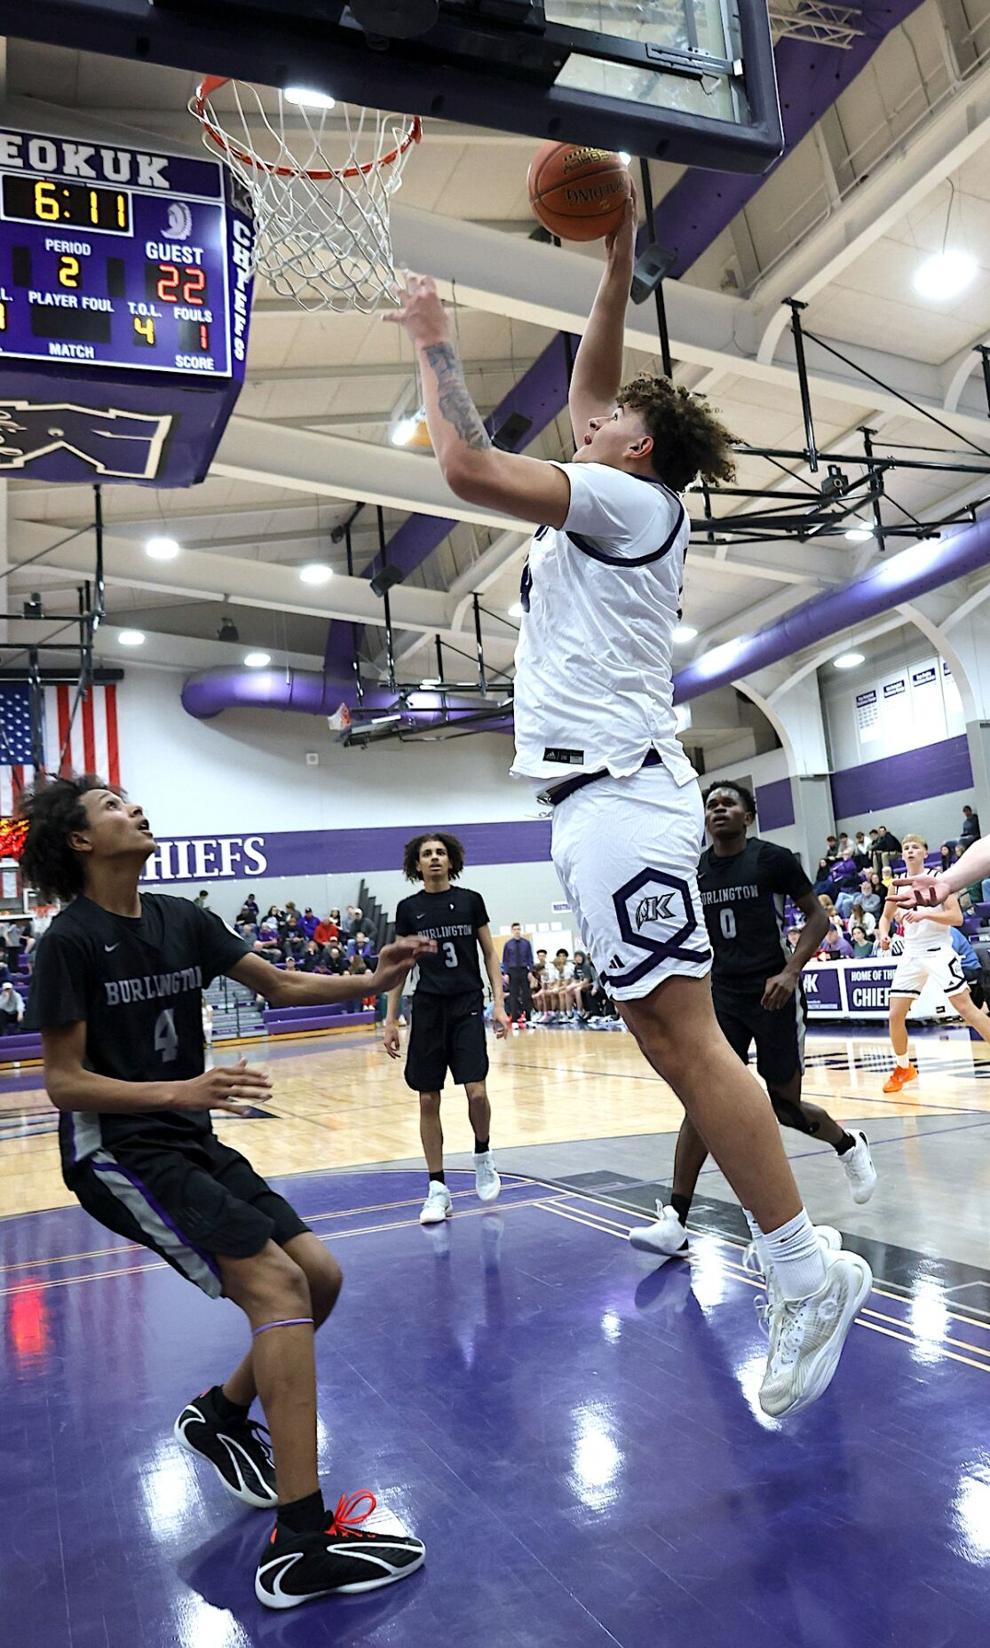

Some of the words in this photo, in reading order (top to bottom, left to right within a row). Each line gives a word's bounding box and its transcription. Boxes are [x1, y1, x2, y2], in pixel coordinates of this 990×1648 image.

[35, 181, 125, 227] 6:11
[45, 238, 92, 256] PERIOD
[146, 241, 204, 265] GUEST
[59, 256, 79, 287] 2
[157, 263, 206, 305] 22
[28, 290, 79, 308] PLAYER
[82, 297, 115, 312] FOUL
[127, 301, 163, 318] T.O.L.
[174, 306, 213, 323] FOULS
[134, 317, 154, 345] 4
[199, 324, 208, 349] 1
[49, 342, 95, 359] MATCH
[175, 354, 214, 370] SCORE
[139, 837, 267, 880] HIEFS
[720, 908, 737, 939] 0
[442, 941, 459, 968] 3
[851, 970, 872, 981] HOME
[872, 970, 881, 980] OF
[154, 1008, 178, 1062] 4
